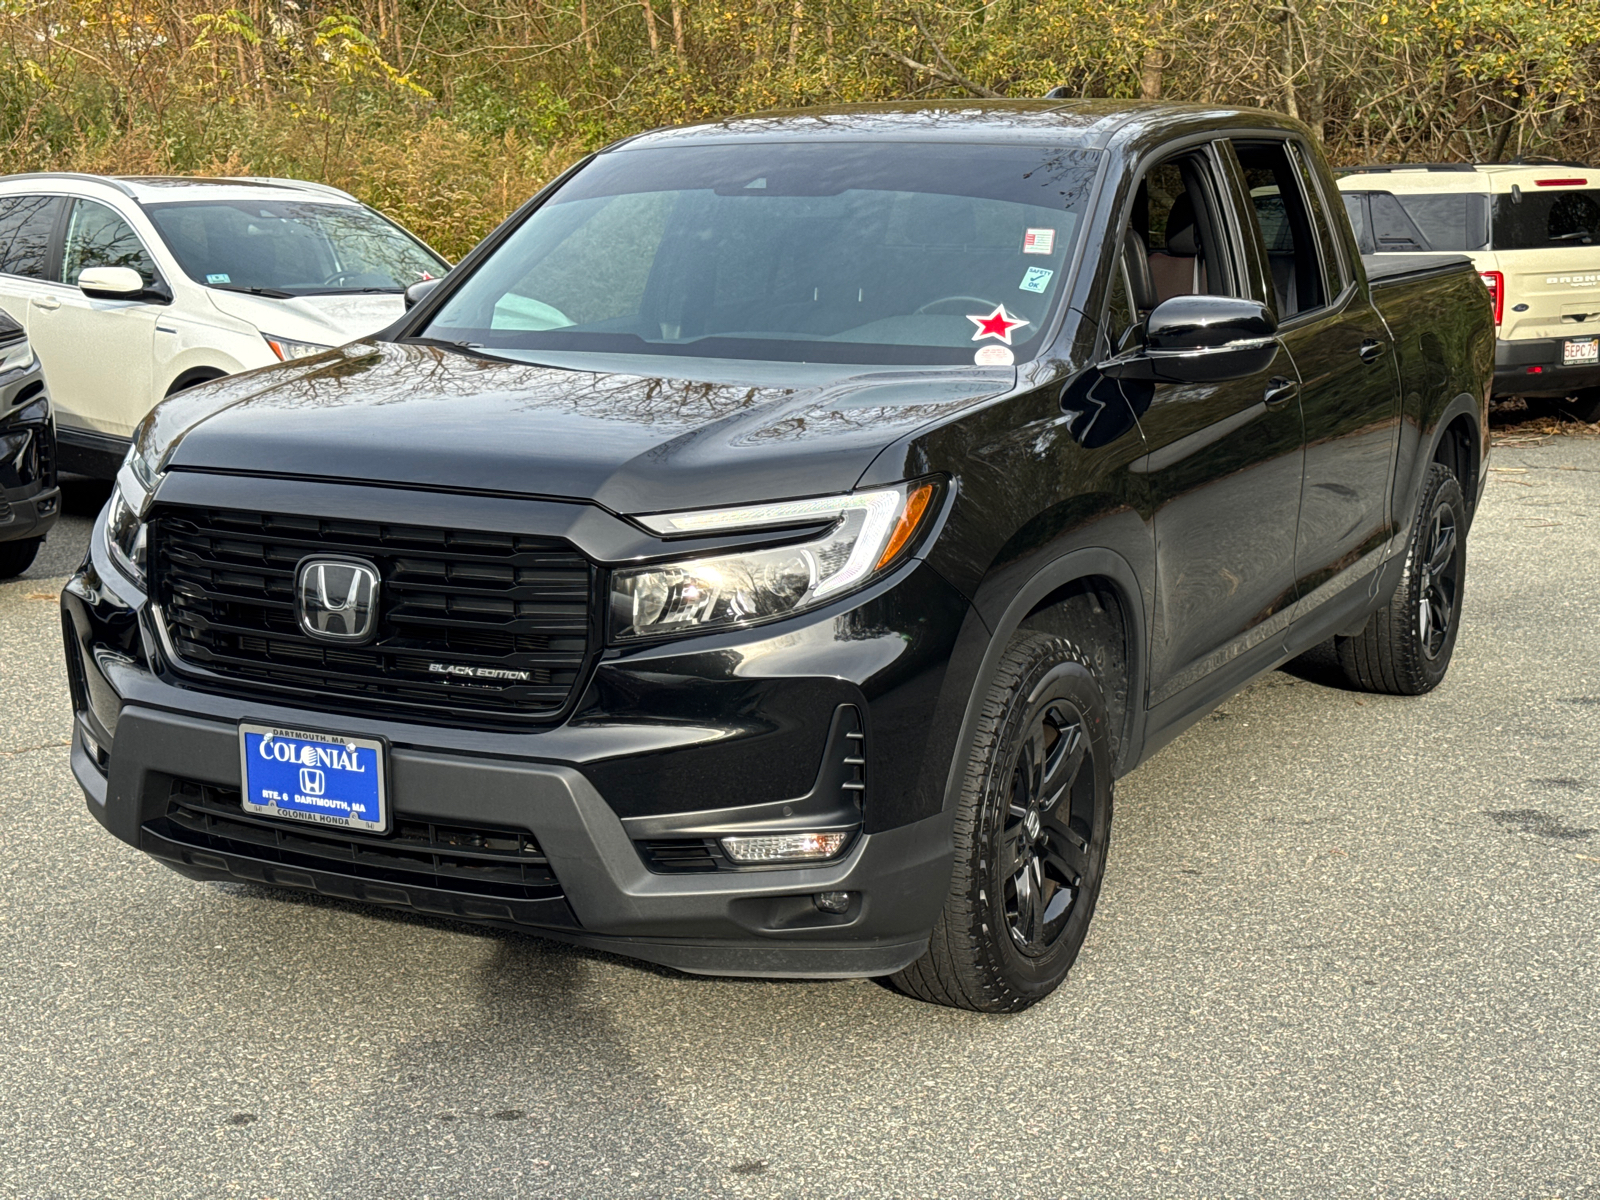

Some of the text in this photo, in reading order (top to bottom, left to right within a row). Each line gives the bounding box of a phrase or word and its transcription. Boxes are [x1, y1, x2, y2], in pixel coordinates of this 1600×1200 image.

[1029, 267, 1051, 276] SAFETY
[1028, 281, 1040, 289] OK
[428, 663, 530, 680] BLACK EDITION
[331, 736, 345, 744] MA
[259, 740, 365, 772] COLONIAL
[262, 789, 366, 812] RTE. 6 DARTMOUTH, MA
[277, 808, 350, 826] COLONIAL HONDA
